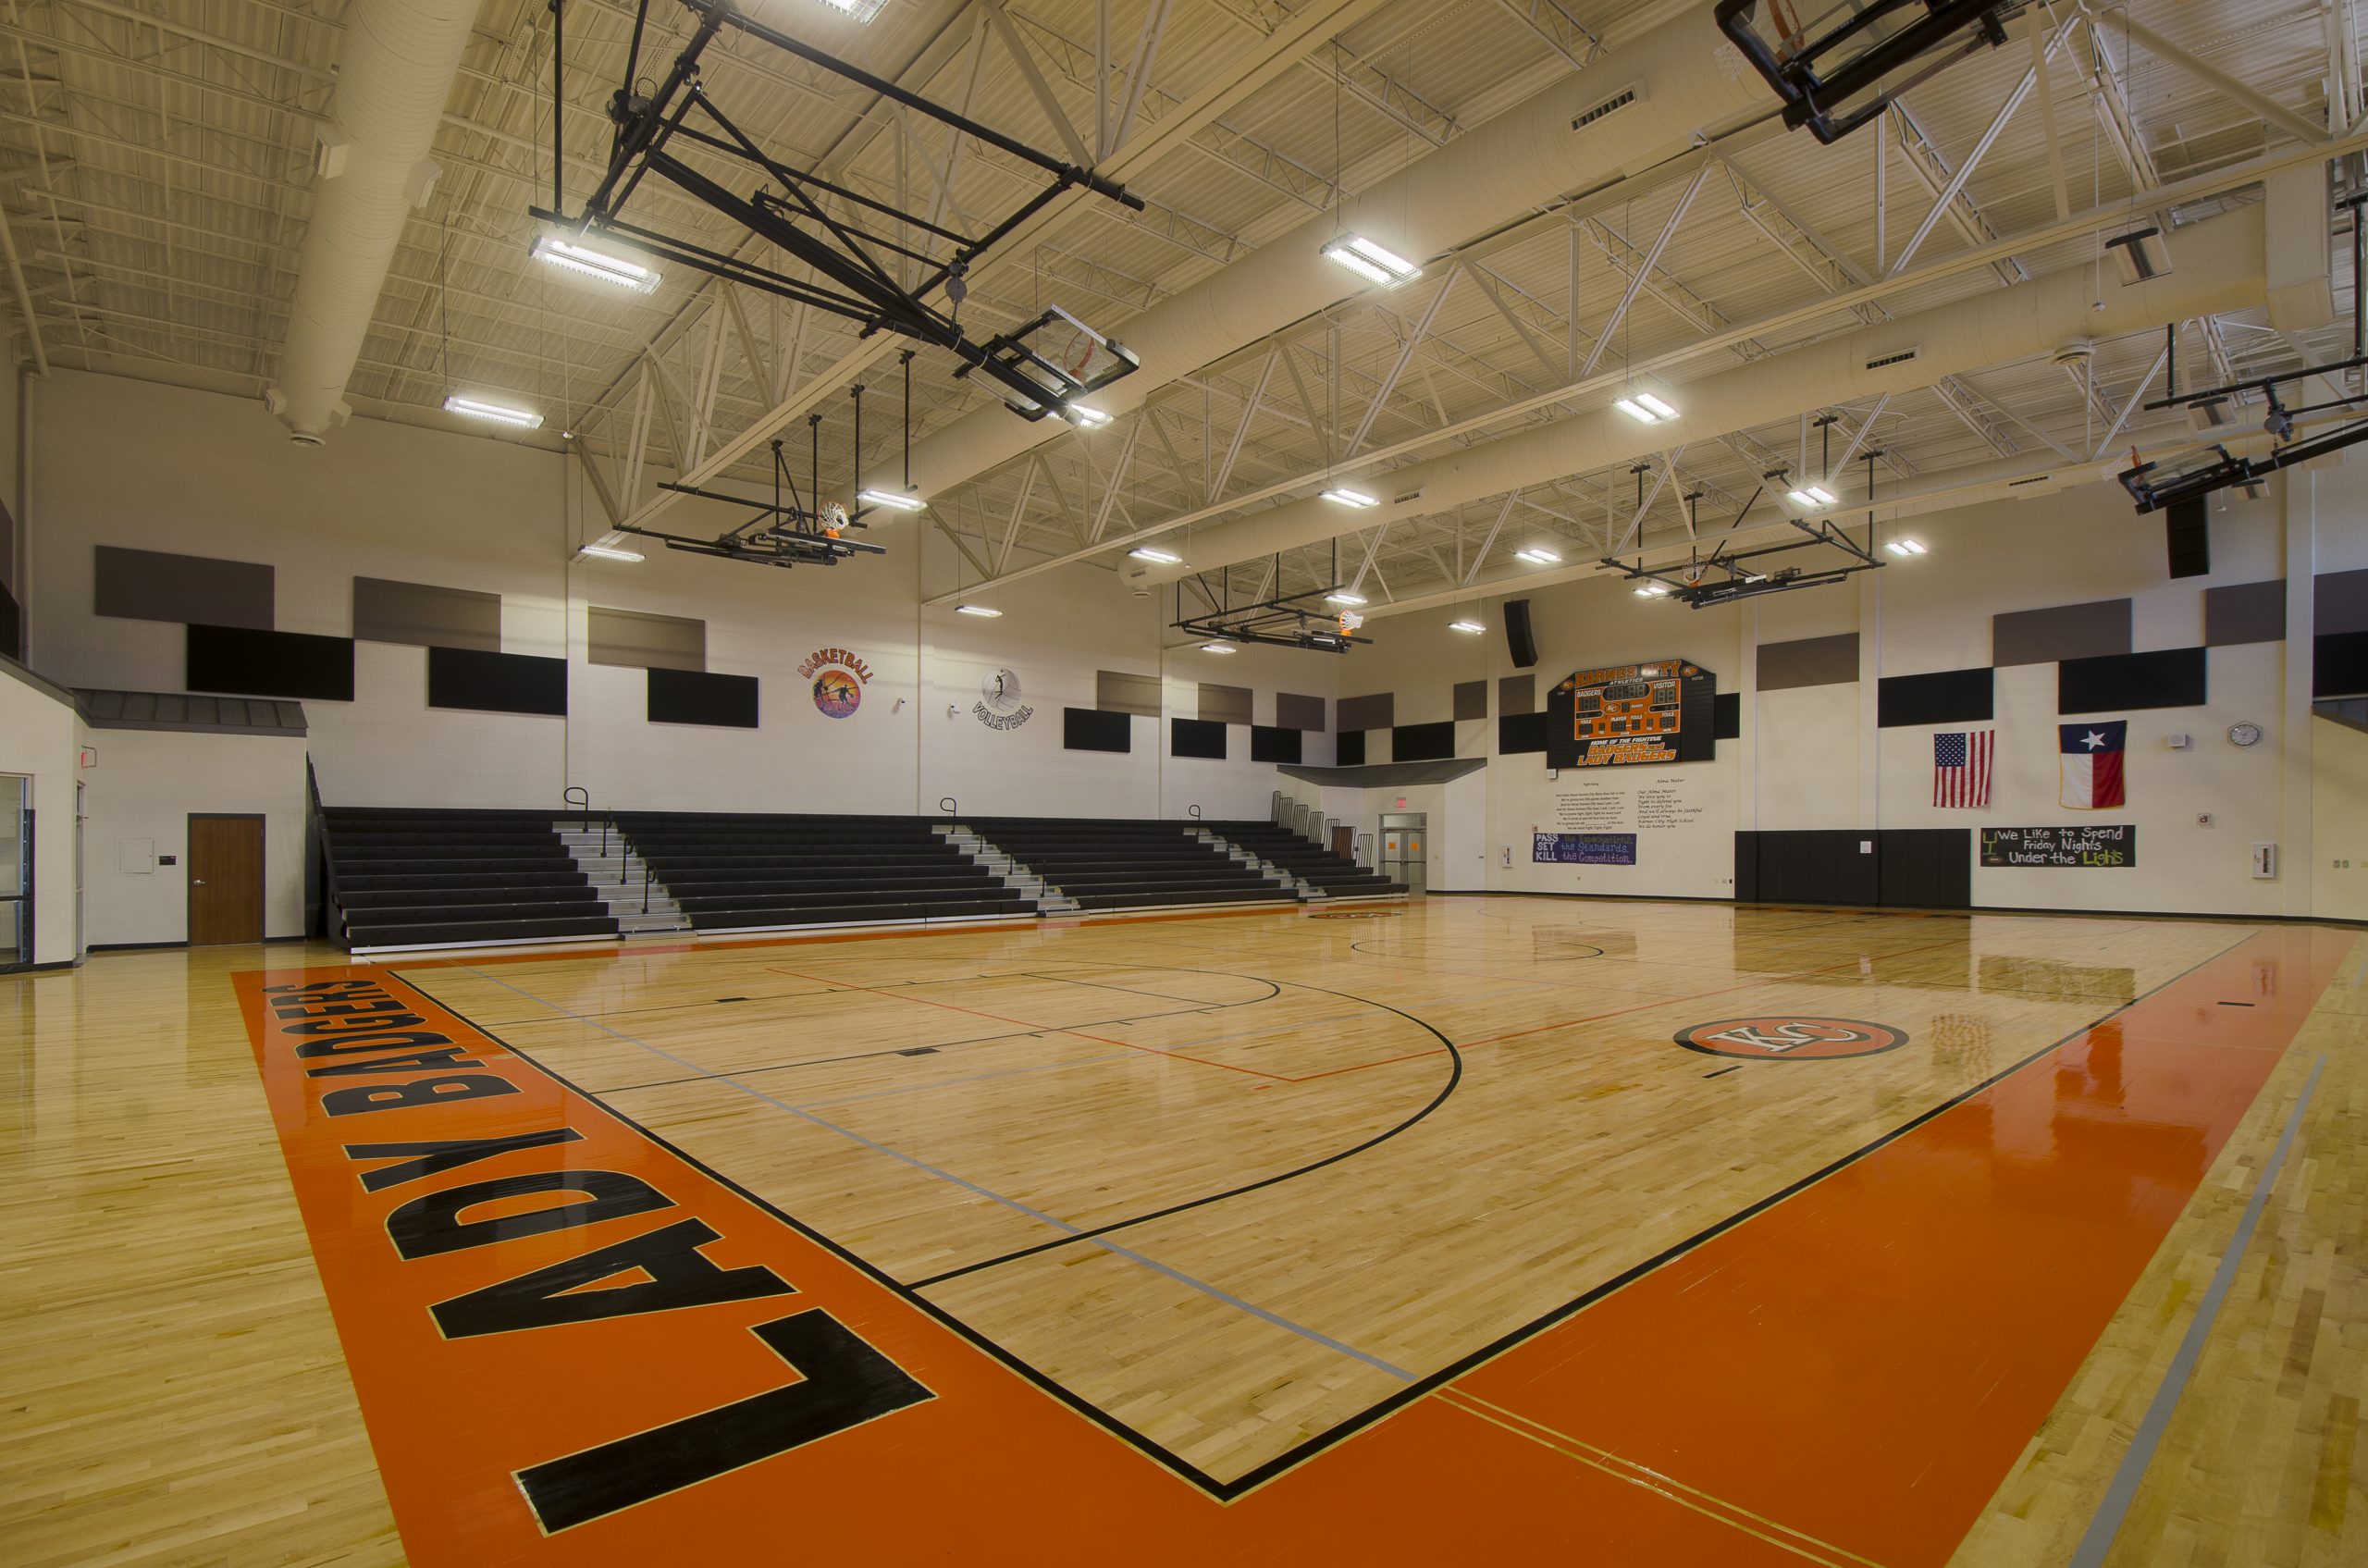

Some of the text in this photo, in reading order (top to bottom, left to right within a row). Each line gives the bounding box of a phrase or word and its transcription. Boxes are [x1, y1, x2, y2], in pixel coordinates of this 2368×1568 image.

[797, 648, 873, 685] BASKETBALL
[1575, 660, 1682, 688] KARNES CITY
[1610, 677, 1644, 685] ATHLETICS
[1653, 681, 1676, 690] VISITOR
[1576, 689, 1602, 698] BADGERS
[972, 701, 1033, 731] VOLLEYBALL
[1587, 742, 1649, 756] BADGERS
[1577, 749, 1676, 766] LADY BADGERS
[1536, 833, 1559, 843] PASS
[1997, 830, 2019, 840] We
[2058, 828, 2075, 837] to
[2081, 826, 2124, 840] Spend
[1537, 842, 1630, 853] SET the Standards.
[2023, 838, 2102, 854] Friday Nights
[1536, 851, 1634, 864] KILL the Competition.
[2009, 849, 2124, 867] Under the Lights
[260, 980, 940, 1539] LADY BADGERS
